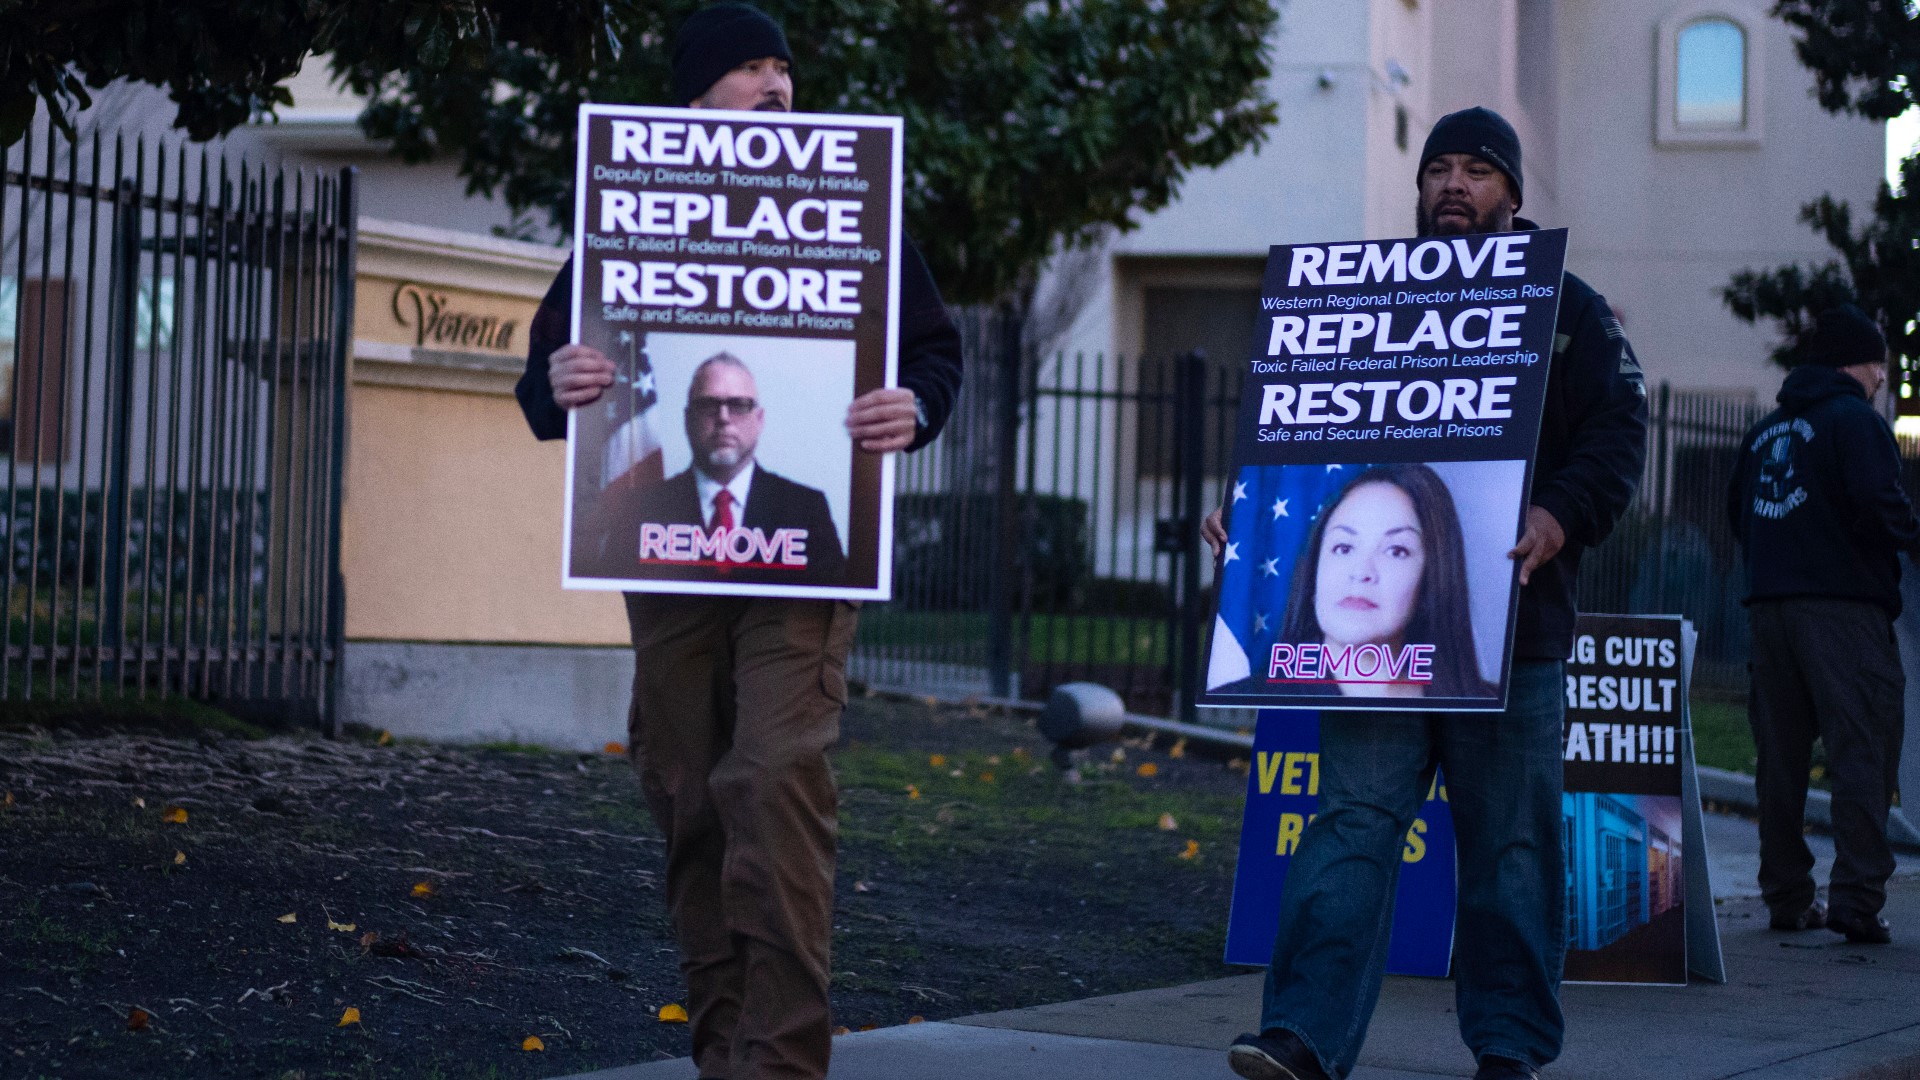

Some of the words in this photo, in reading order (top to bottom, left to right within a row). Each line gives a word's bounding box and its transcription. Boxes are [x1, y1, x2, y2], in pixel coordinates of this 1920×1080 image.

[611, 119, 858, 173] REMOVE
[593, 164, 650, 185] Deputy
[654, 168, 716, 186] Director
[720, 170, 783, 188] Thomas
[787, 174, 817, 192] Ray
[819, 175, 869, 193] Hinkle
[600, 189, 863, 243] REPLACE
[586, 233, 626, 250] Toxic
[628, 235, 676, 252] Failed
[679, 237, 739, 256] Federal
[742, 240, 791, 257] Prison
[794, 243, 882, 264] Leadership
[1288, 234, 1531, 287] REMOVE
[600, 259, 863, 314] RESTORE
[1261, 296, 1322, 311] Western
[1326, 292, 1392, 310] Regional
[1396, 289, 1457, 306] Director
[1459, 286, 1517, 302] Melissa
[1521, 283, 1555, 299] Rios
[391, 280, 519, 350] Verona
[602, 304, 638, 322] Safe
[640, 307, 673, 323] and
[675, 308, 731, 325] Secure
[734, 310, 795, 328] Federal
[798, 313, 855, 331] Prisons
[1267, 304, 1527, 356] REPLACE
[1250, 359, 1287, 374] Toxic
[1290, 357, 1336, 373] Failed
[1339, 355, 1397, 372] Federal
[1401, 353, 1448, 370] Prison
[1451, 350, 1540, 369] Leadership
[1258, 375, 1518, 425] RESTORE
[1257, 427, 1291, 443] Safe
[1293, 427, 1323, 442] and
[1327, 427, 1380, 442] Secure
[1383, 424, 1442, 440] Federal
[1446, 422, 1503, 438] Prisons
[638, 522, 809, 566] REMOVE
[1268, 642, 1436, 681] REMOVE
[1605, 635, 1676, 669] CUTS
[1566, 674, 1677, 713] RESULT
[1562, 721, 1675, 765] ATH!!!
